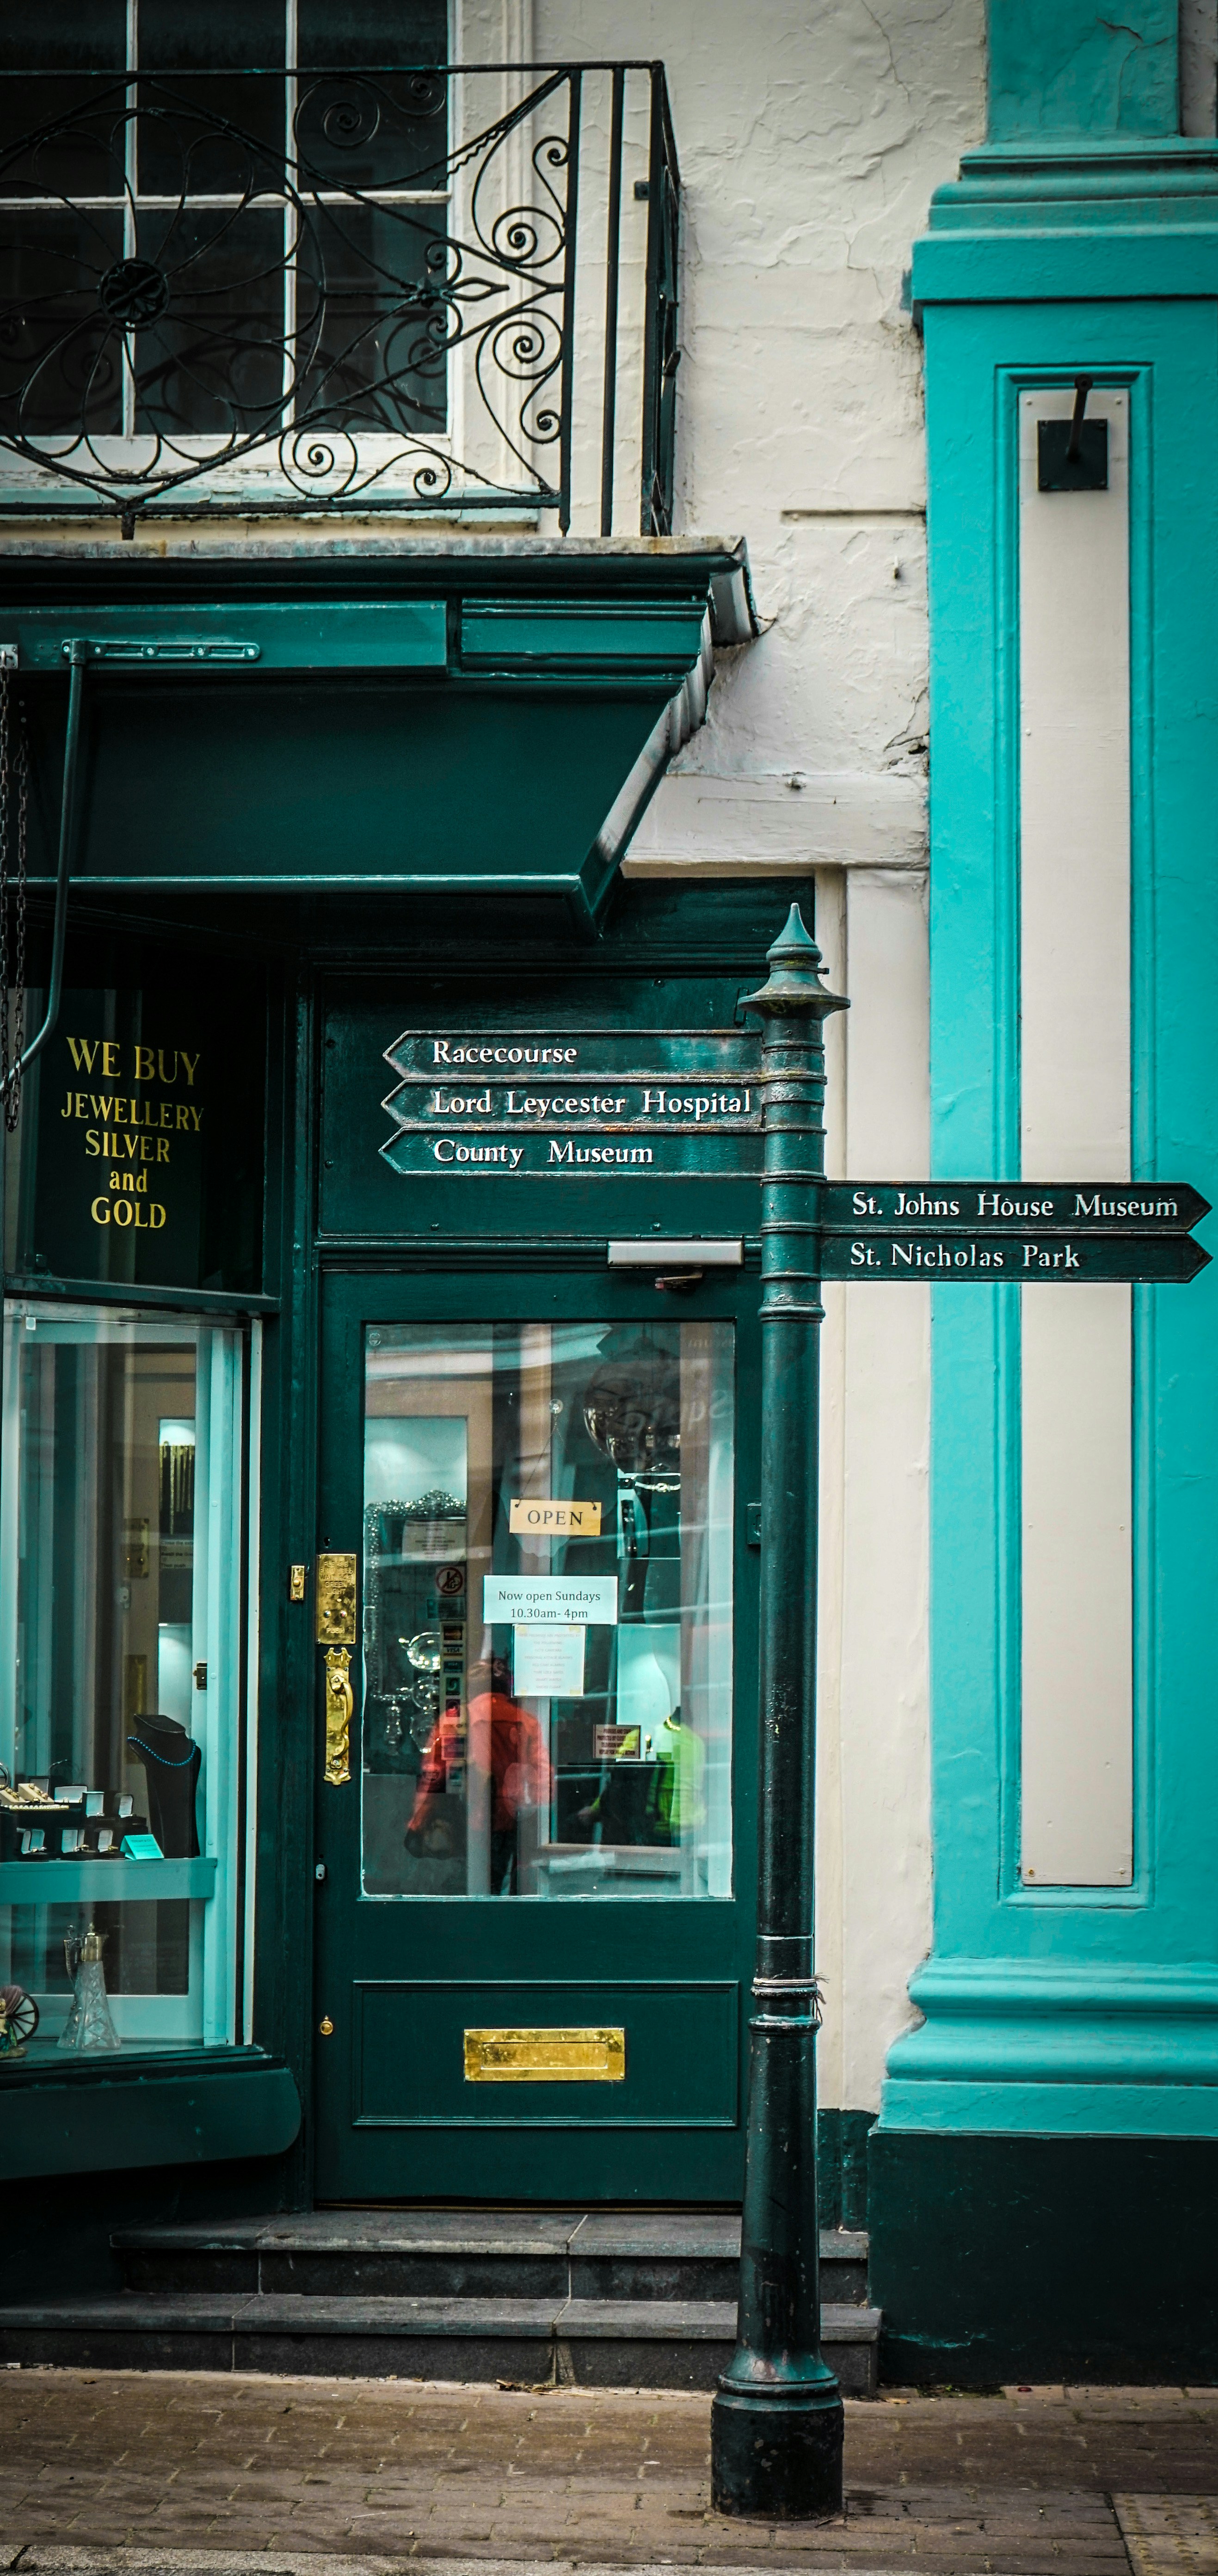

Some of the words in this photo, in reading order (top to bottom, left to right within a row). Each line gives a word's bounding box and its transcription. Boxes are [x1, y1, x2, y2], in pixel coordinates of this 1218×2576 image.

[66, 1037, 120, 1077] WE
[134, 1045, 200, 1086] BUY
[433, 1040, 578, 1064] Racecourse
[61, 1092, 204, 1131] JEWELLERY
[433, 1090, 492, 1114] Lord
[506, 1091, 626, 1118] Leycester
[643, 1090, 750, 1121] Hospital
[86, 1129, 170, 1162] SILVER
[433, 1139, 523, 1168] County
[547, 1140, 653, 1164] Museum
[109, 1168, 148, 1193] and
[91, 1196, 166, 1228] GOLD
[852, 1192, 883, 1216] St.
[894, 1192, 960, 1217] Johns
[978, 1193, 1054, 1217] House
[1074, 1193, 1178, 1217] Museum
[850, 1242, 881, 1267] St.
[890, 1243, 1003, 1268] Nicholas
[1022, 1244, 1080, 1268] Park
[528, 1510, 583, 1525] OPEN
[498, 1591, 523, 1600] Now
[526, 1593, 552, 1603] open
[555, 1591, 601, 1603] Sundays
[511, 1608, 561, 1618] 10.30am-
[564, 1609, 588, 1620] 4pm
